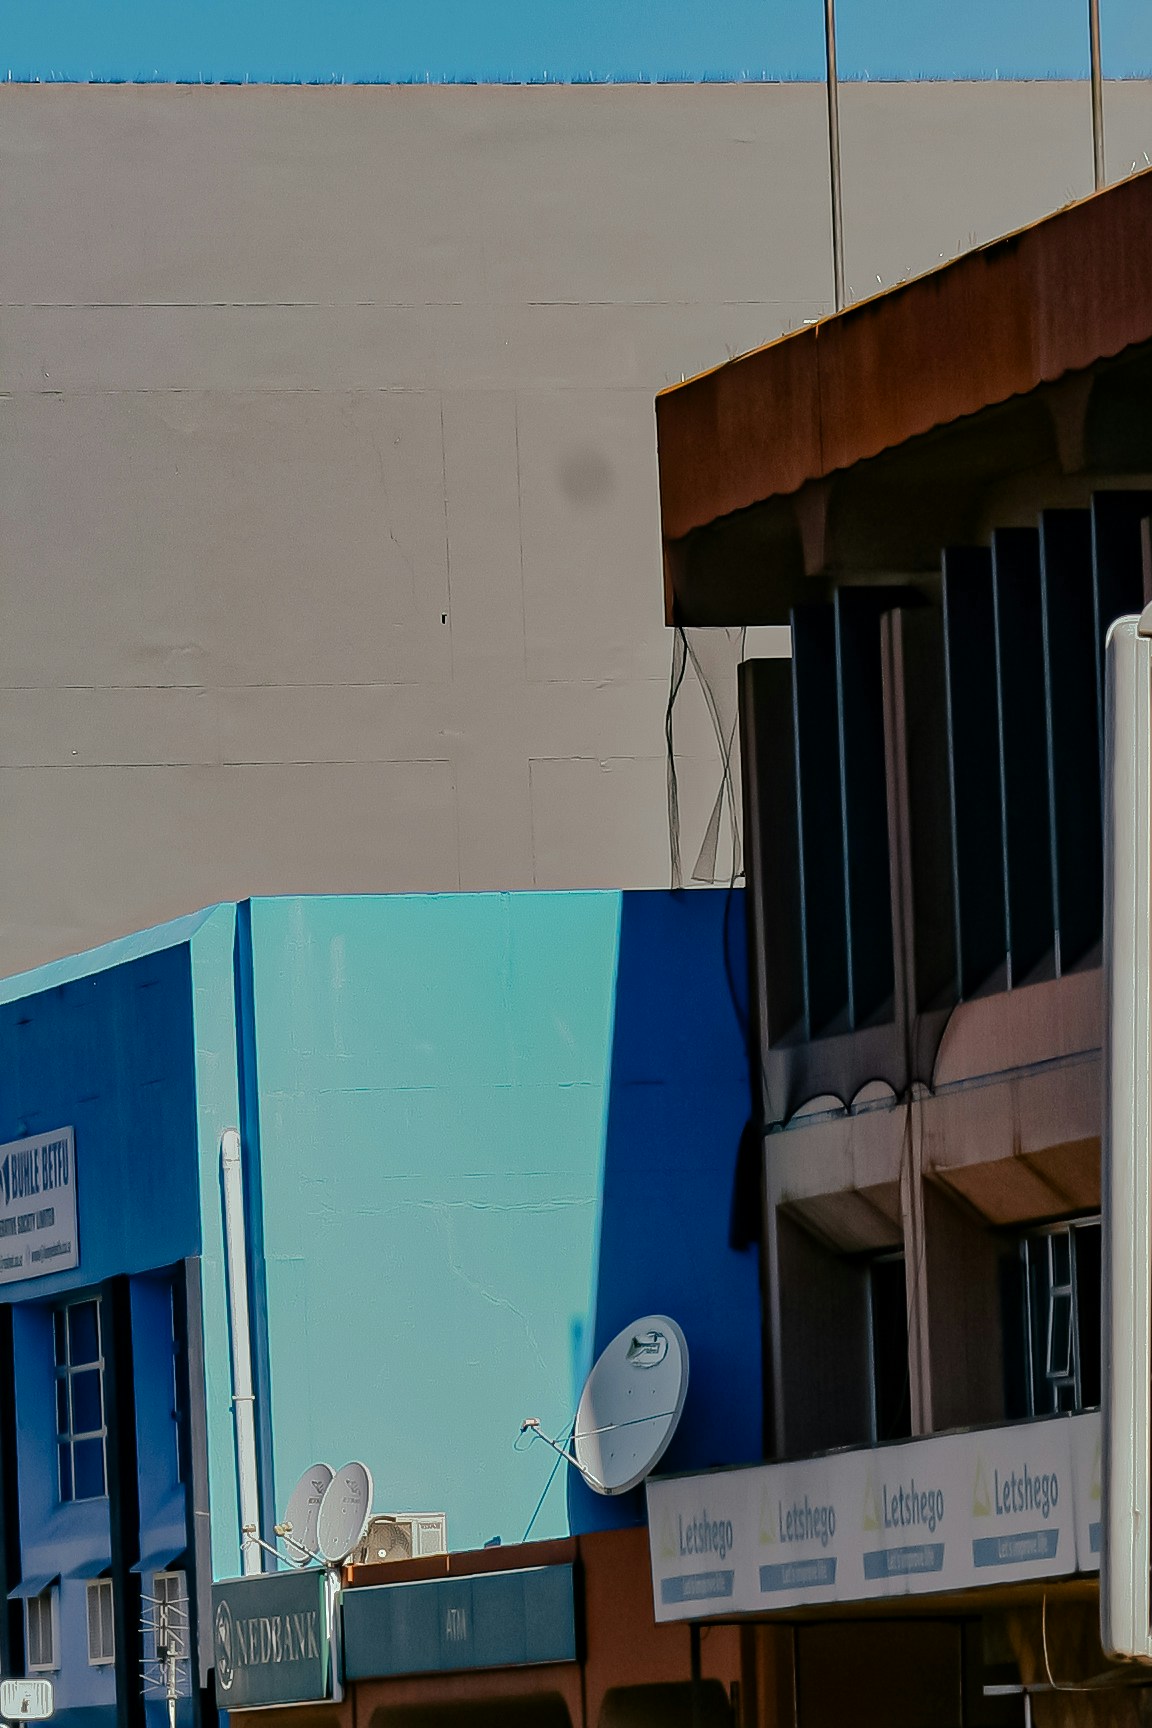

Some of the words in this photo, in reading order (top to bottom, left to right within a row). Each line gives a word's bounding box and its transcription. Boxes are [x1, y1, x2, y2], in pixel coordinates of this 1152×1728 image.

[883, 1478, 944, 1533] Letshego
[994, 1463, 1059, 1519] Letshego
[678, 1507, 734, 1560] Letshego
[778, 1495, 836, 1548] Letshego
[235, 1611, 320, 1667] NEDBANK
